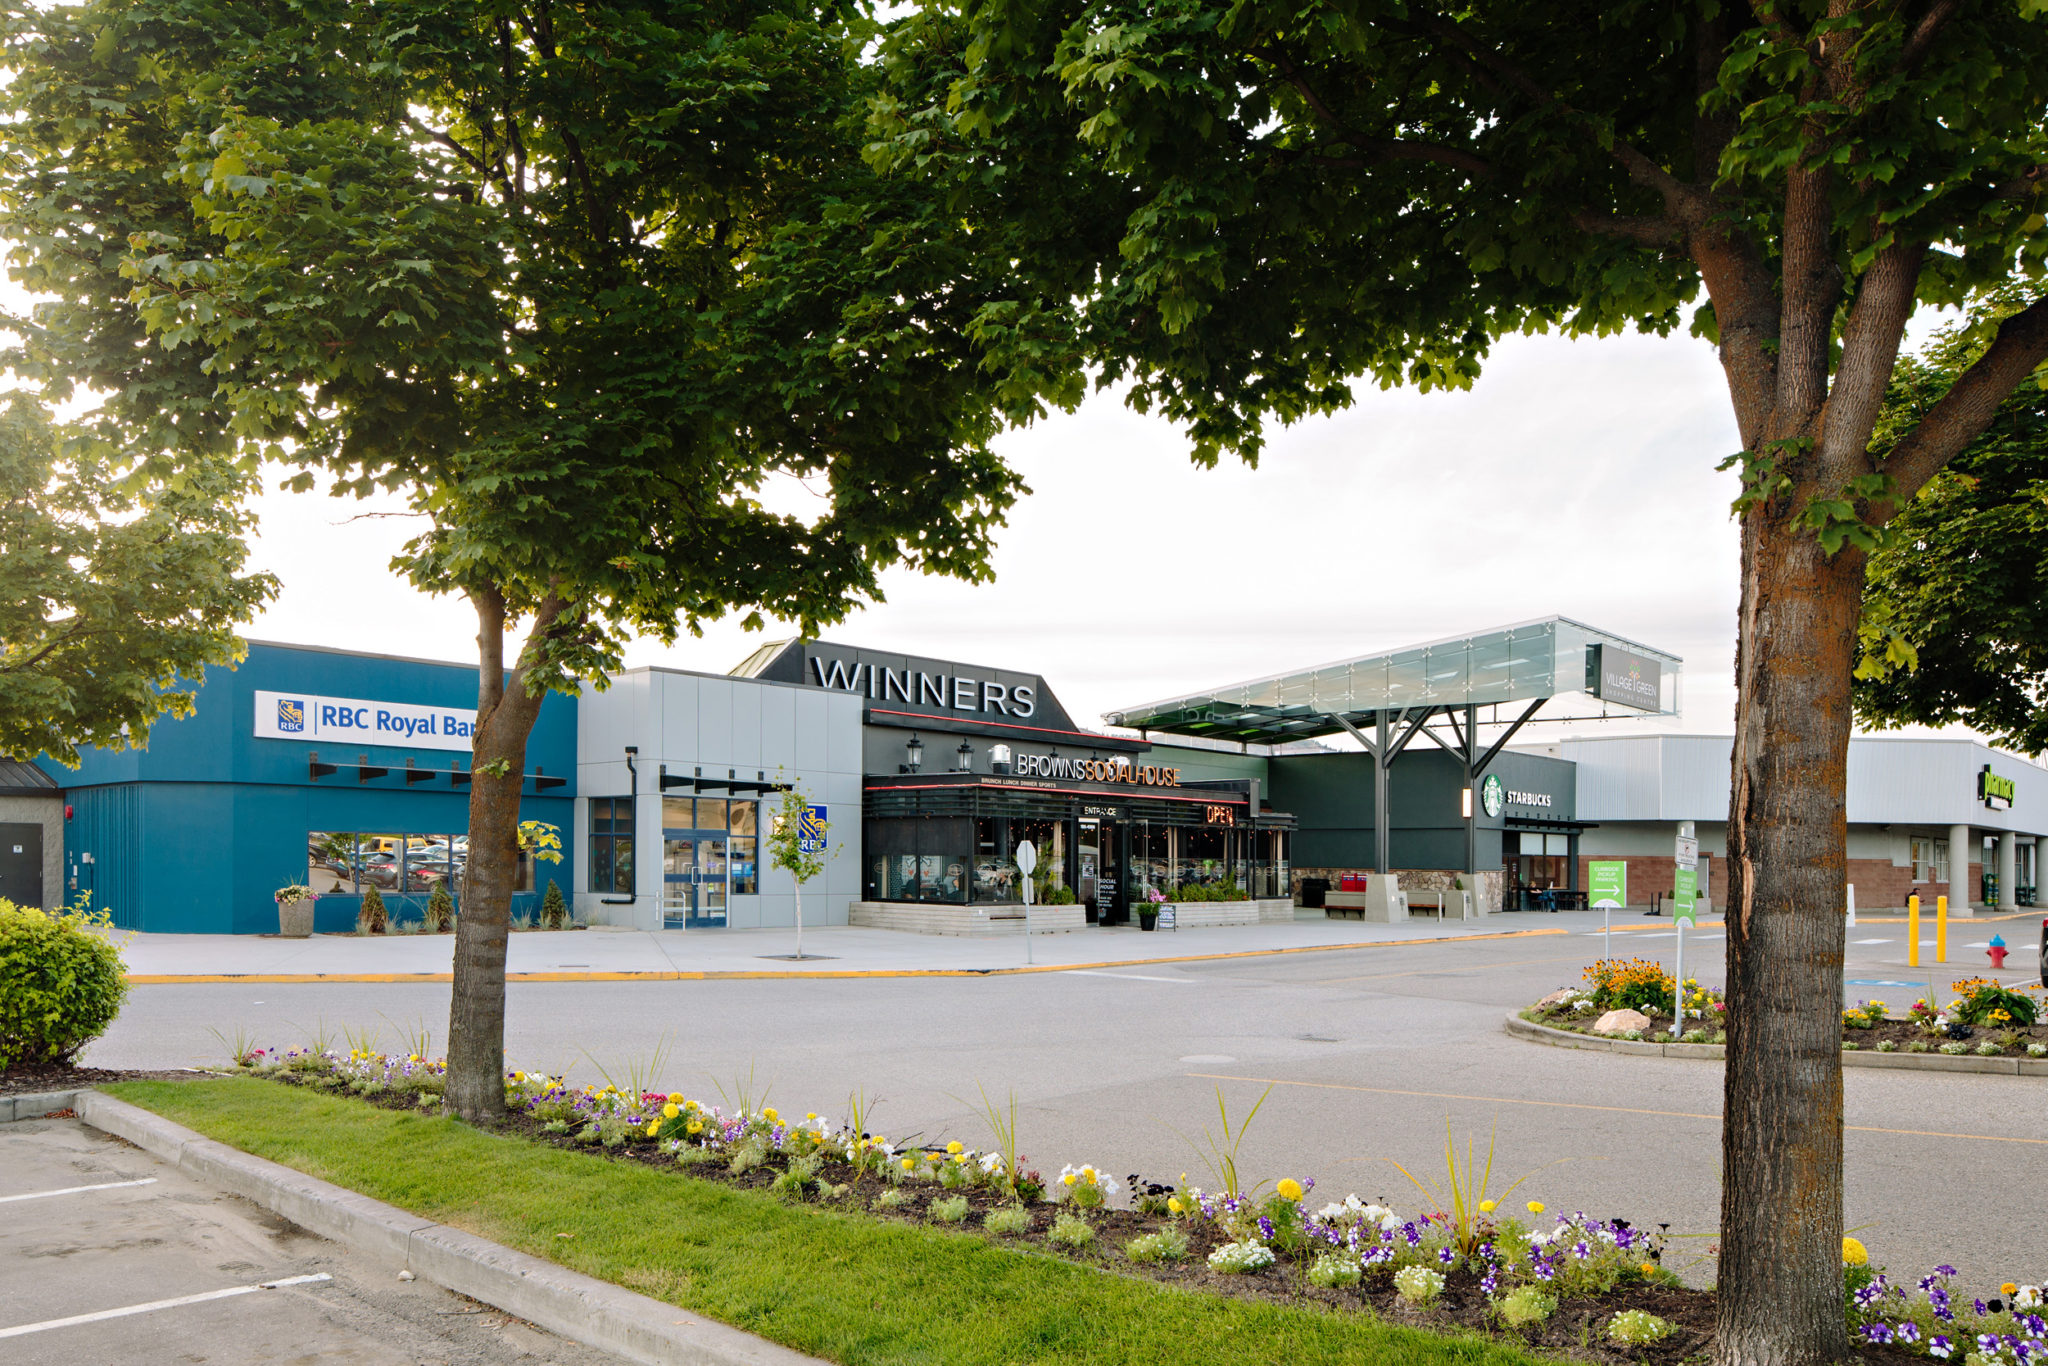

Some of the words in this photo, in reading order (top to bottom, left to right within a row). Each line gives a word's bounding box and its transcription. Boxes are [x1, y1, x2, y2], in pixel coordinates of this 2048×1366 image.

[811, 656, 1035, 718] WINNERS
[1606, 671, 1633, 691] VILLAGE
[1636, 680, 1657, 698] GREEN
[280, 721, 302, 731] RBC
[322, 705, 369, 729] RBC
[376, 710, 436, 738] Royal
[981, 777, 1002, 785] BRUNCH
[1984, 764, 2015, 808] pharmacy
[1507, 790, 1551, 807] STARBUCKS
[1084, 806, 1117, 816] ENTRANCE
[1207, 805, 1233, 826] OPEN
